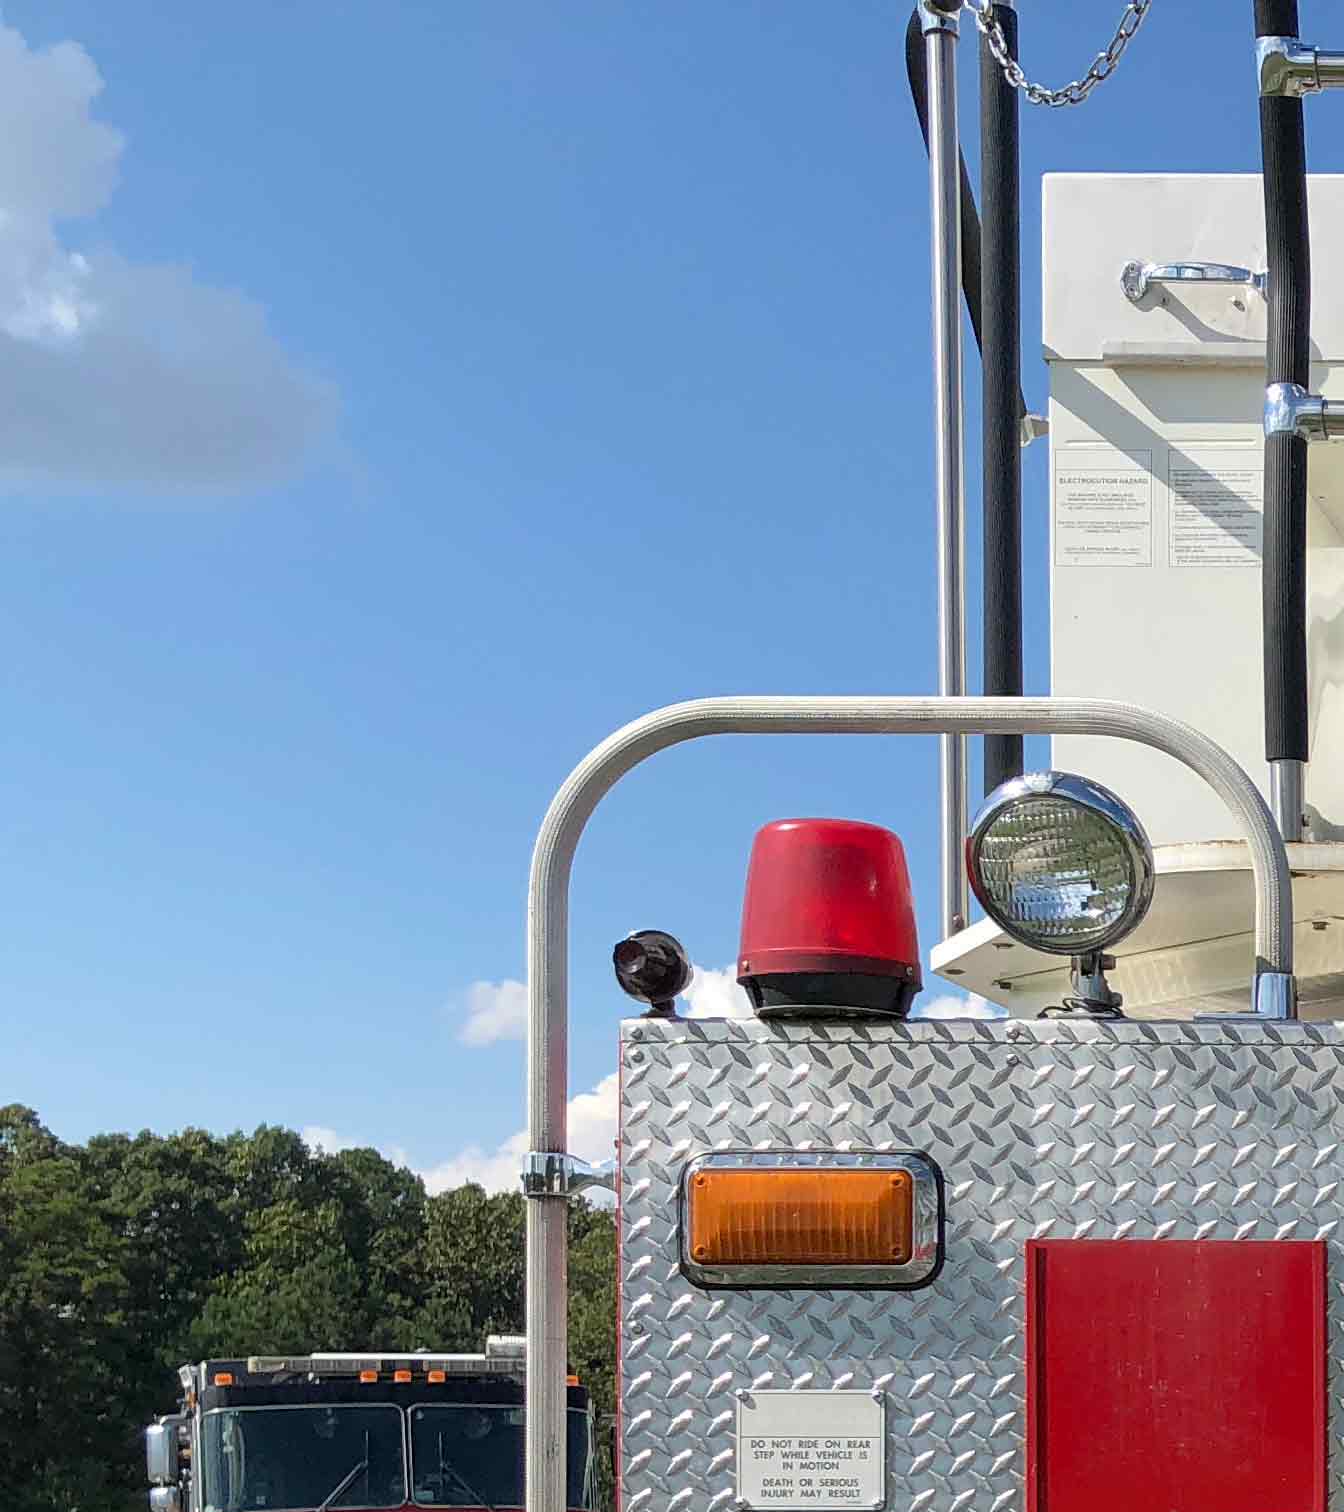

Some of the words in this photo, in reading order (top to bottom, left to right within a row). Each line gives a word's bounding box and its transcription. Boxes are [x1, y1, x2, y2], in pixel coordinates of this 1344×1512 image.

[750, 1440, 765, 1449] DO
[771, 1440, 792, 1449] NOT
[798, 1440, 818, 1449] RIDE
[825, 1440, 841, 1449] ON
[847, 1440, 871, 1449] REAR
[753, 1451, 775, 1460] STEP
[781, 1451, 809, 1460] WHILE
[816, 1451, 853, 1460] VEHICLE
[859, 1451, 868, 1460] IS
[782, 1461, 793, 1470] IN
[799, 1461, 839, 1470] MOTION
[762, 1478, 793, 1487] DEATH
[799, 1478, 813, 1487] OR
[819, 1478, 859, 1487] SERIOUS
[761, 1489, 794, 1498] INJURY
[800, 1489, 822, 1498] MAY
[828, 1489, 861, 1498] RESULT
